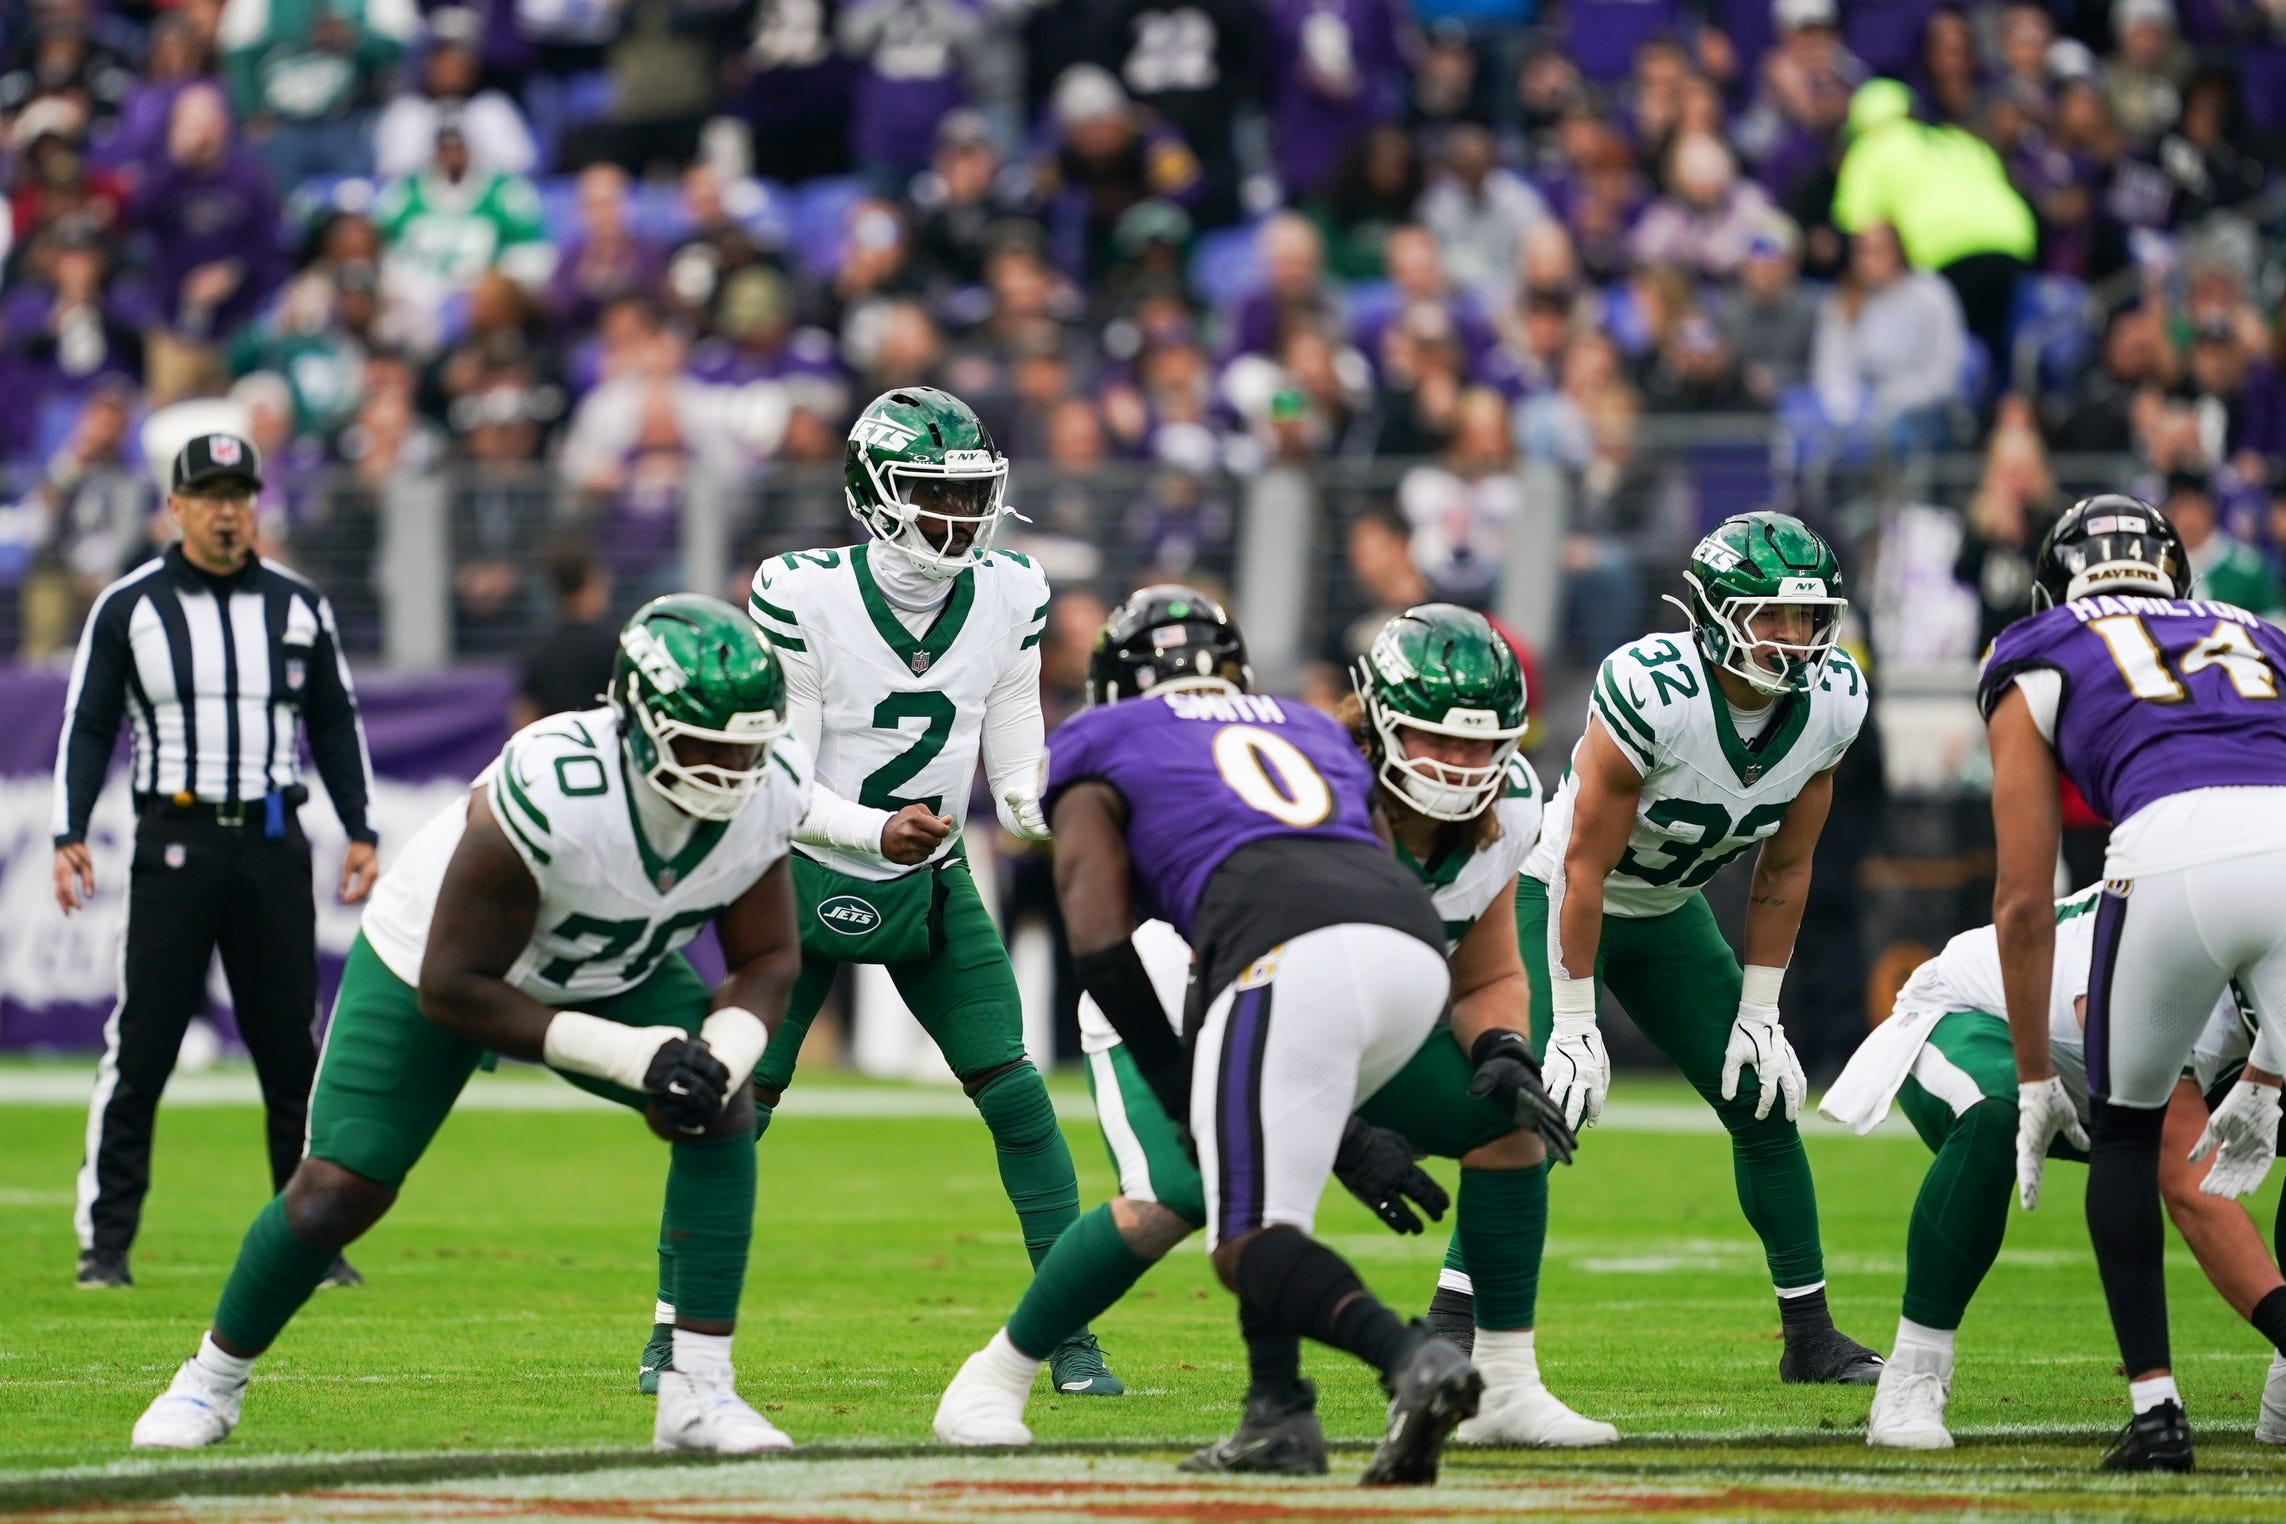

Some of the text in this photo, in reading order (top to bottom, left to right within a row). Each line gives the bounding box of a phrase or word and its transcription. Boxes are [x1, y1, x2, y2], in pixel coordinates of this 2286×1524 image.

[2066, 594, 2260, 629] HAMILTON
[2087, 568, 2159, 583] RAVENS
[1629, 638, 1700, 707] 32
[1818, 646, 1859, 697] 3
[2087, 614, 2279, 702] 14
[534, 720, 609, 797] 70
[859, 690, 957, 818] 2
[1212, 723, 1331, 829] 0
[1614, 797, 1797, 889] 32
[539, 903, 728, 989] 70
[823, 904, 875, 925] JETS
